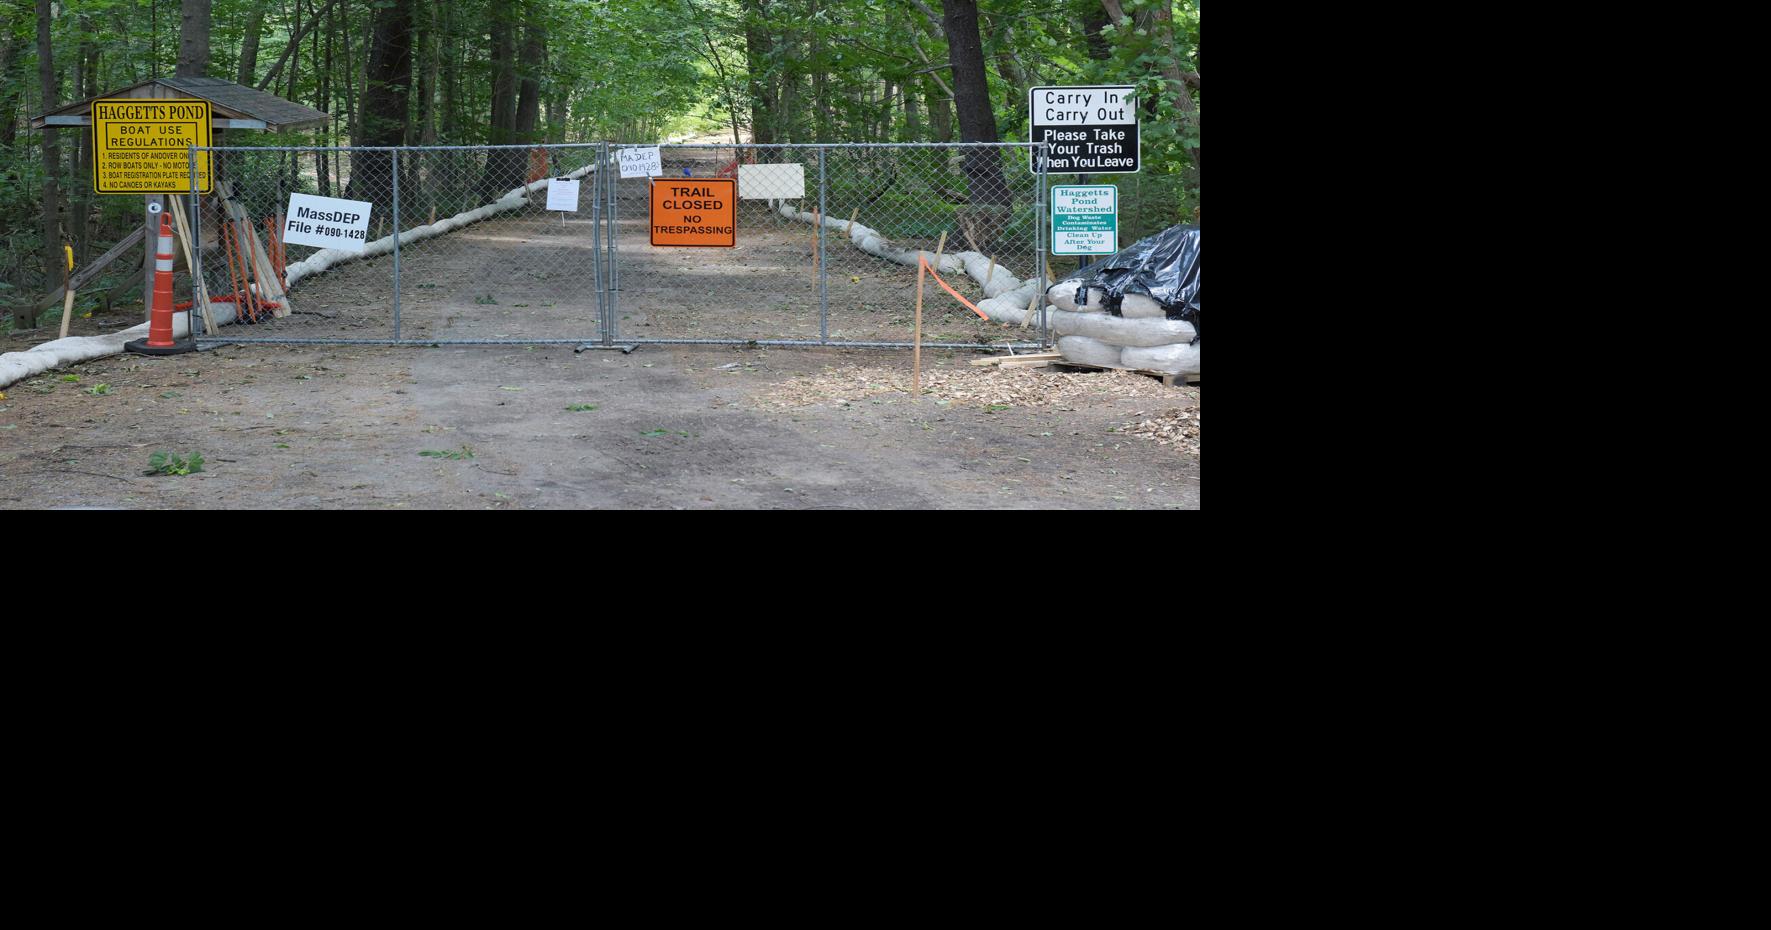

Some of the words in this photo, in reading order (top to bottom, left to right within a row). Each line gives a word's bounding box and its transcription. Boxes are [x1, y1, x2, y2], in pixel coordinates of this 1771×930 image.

[1046, 92, 1092, 107] Carry
[1104, 91, 1118, 104] In
[98, 106, 166, 120] HAGGETTS
[169, 106, 204, 120] POND
[1046, 108, 1088, 124] Carry
[1098, 108, 1124, 120] Out
[120, 126, 151, 135] BOAT
[160, 126, 182, 134] USE
[1044, 130, 1087, 141] Please
[1093, 128, 1126, 140] Take
[111, 138, 193, 147] REGULATIONS
[1048, 143, 1080, 154] Your
[1086, 142, 1122, 154] Trash
[1072, 156, 1096, 168] You
[1097, 156, 1134, 168] Leave
[671, 188, 715, 197] TRAIL
[662, 200, 722, 210] CLOSED
[297, 206, 360, 224] MassDEP
[288, 220, 312, 234] File
[654, 226, 732, 234] TRESPASSING
